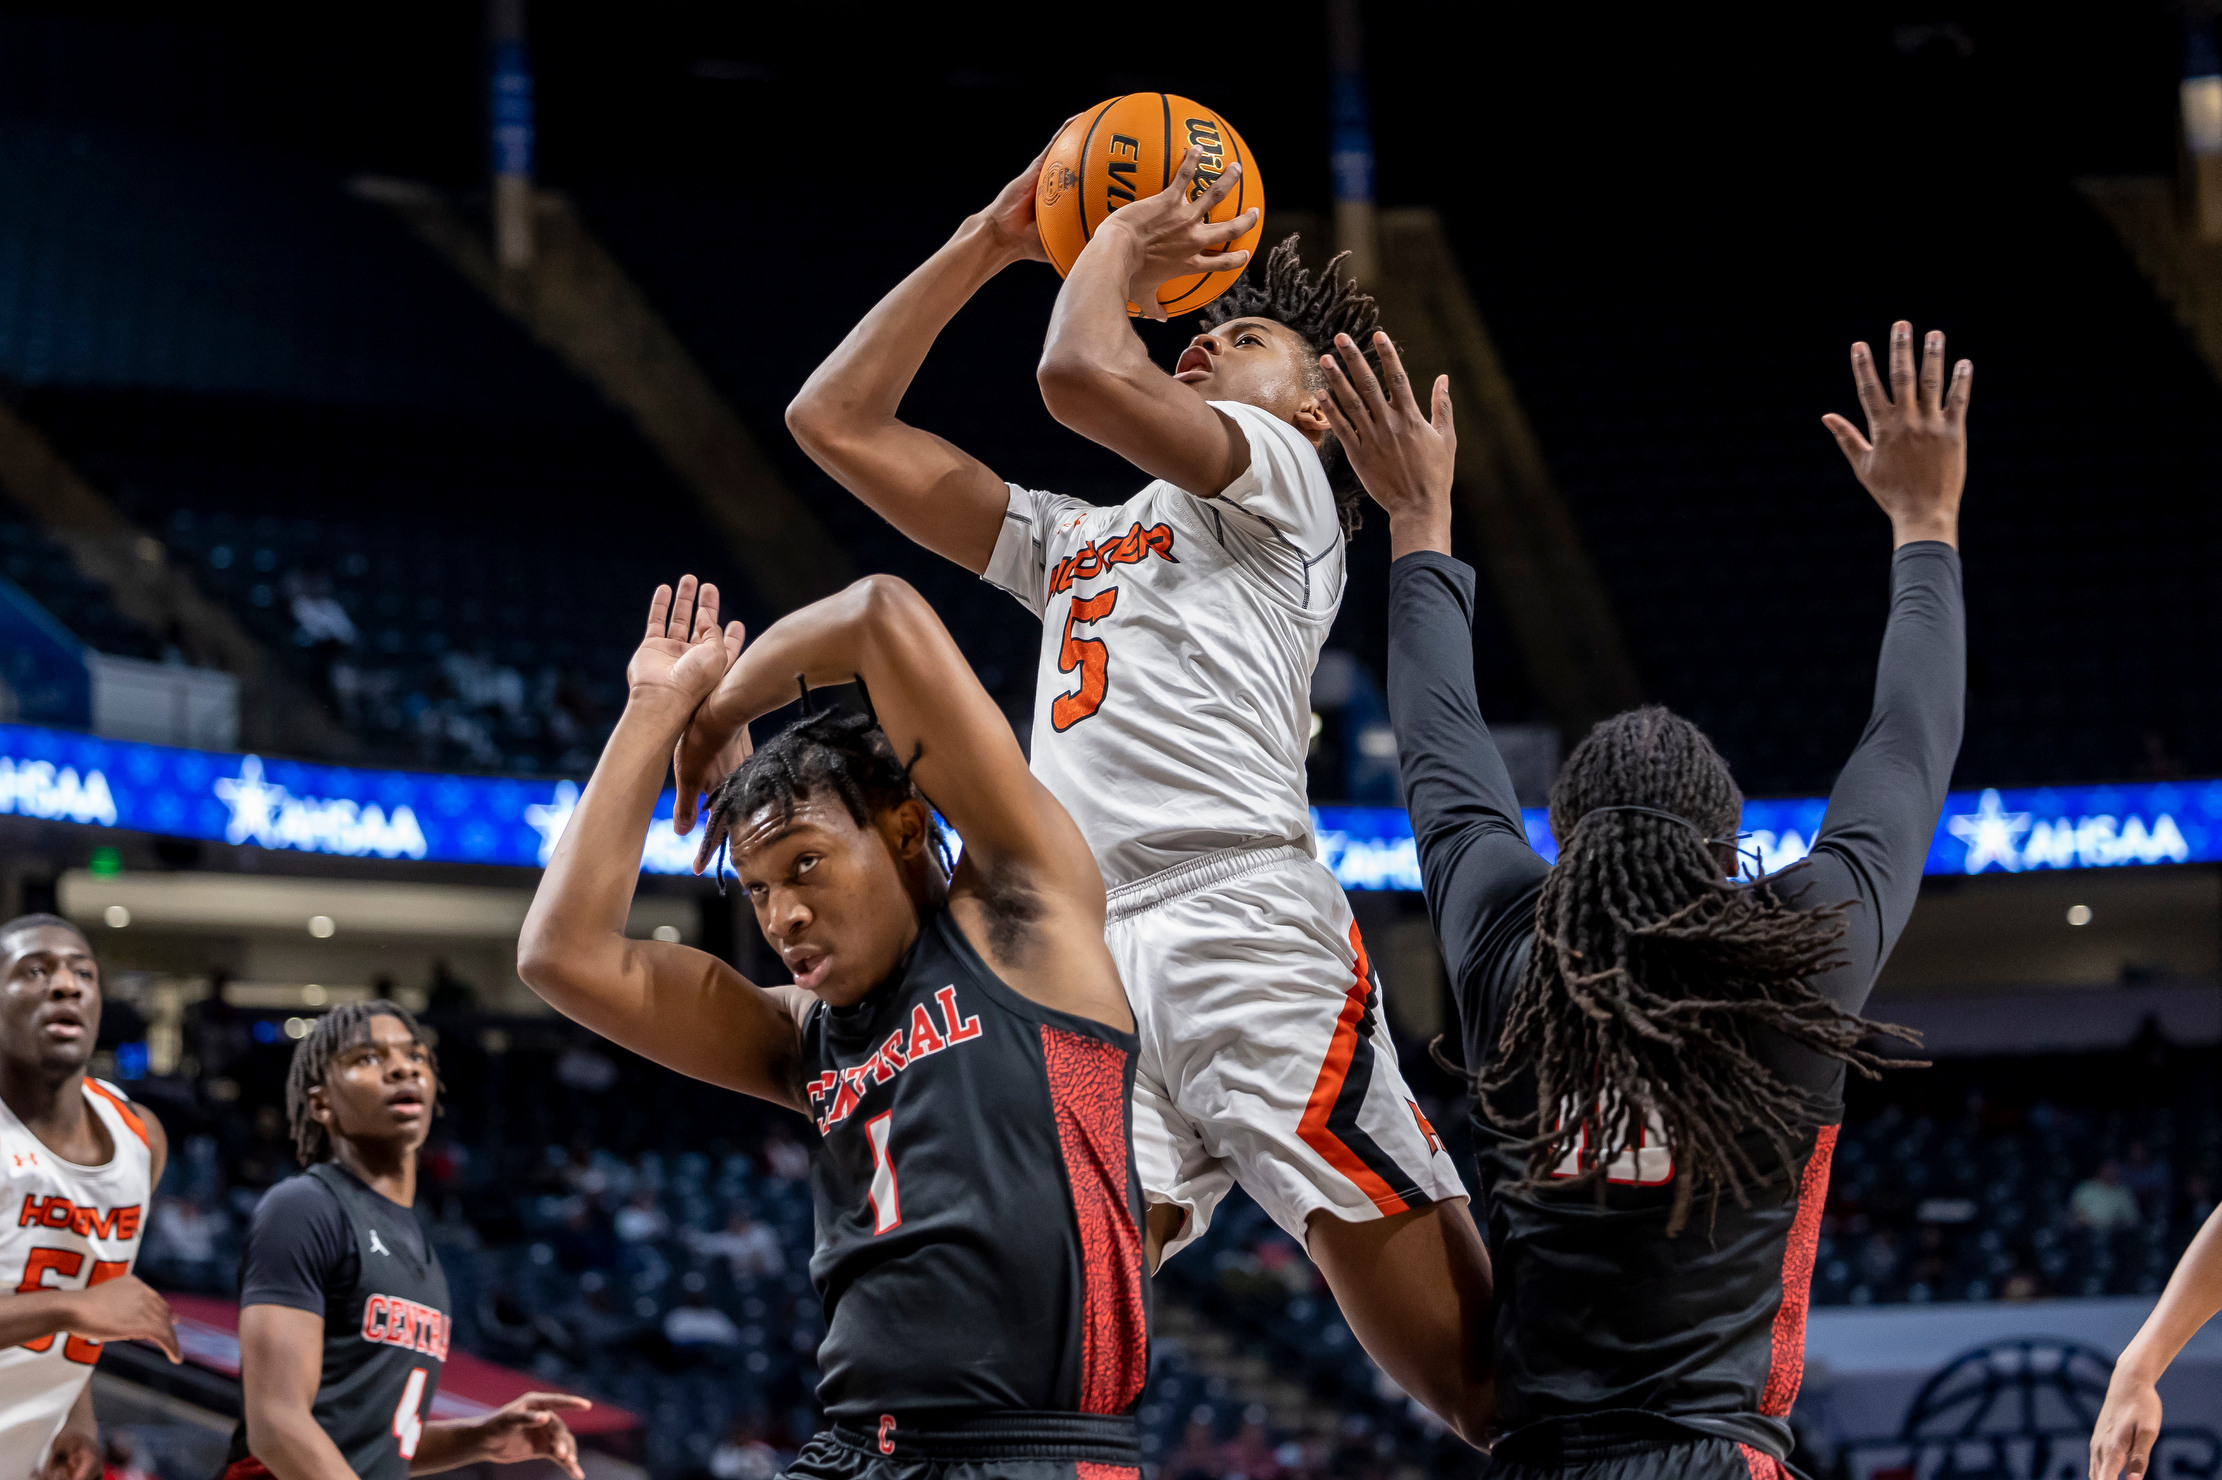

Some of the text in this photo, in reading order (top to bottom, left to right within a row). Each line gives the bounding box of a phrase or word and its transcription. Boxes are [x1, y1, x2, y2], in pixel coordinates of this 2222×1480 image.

[1051, 585, 1119, 733] 5
[864, 1108, 902, 1237] 1
[18, 1192, 141, 1241] HOOVE
[361, 1292, 453, 1363] CENTRA
[391, 1366, 429, 1460] 4
[878, 1413, 897, 1455] C
